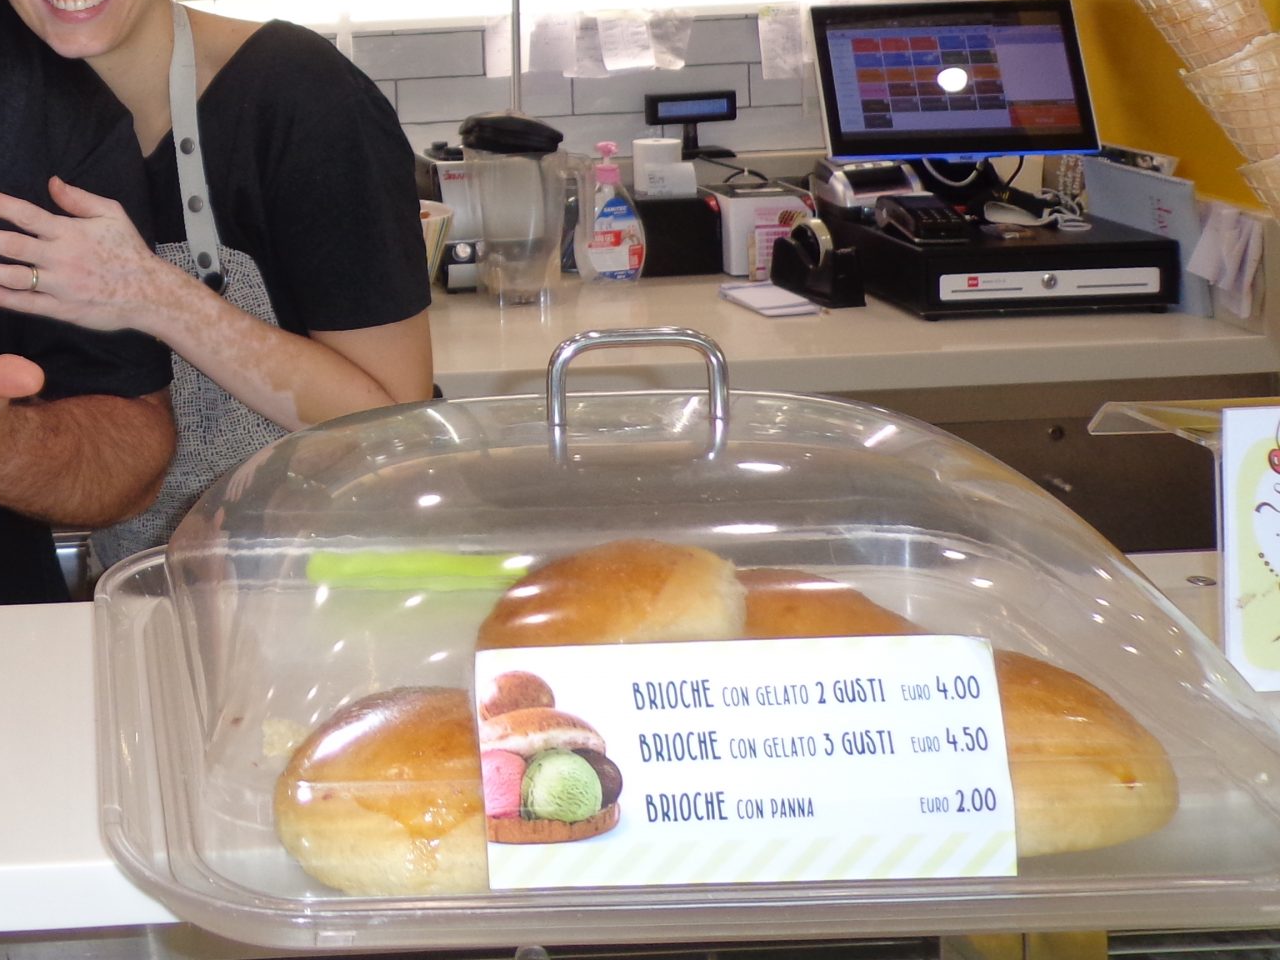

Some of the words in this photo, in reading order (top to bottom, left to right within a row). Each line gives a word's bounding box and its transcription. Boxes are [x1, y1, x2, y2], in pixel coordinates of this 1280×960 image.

[632, 679, 715, 710] BRIOCHE
[722, 686, 750, 707] CON
[755, 684, 809, 706] GELATO
[815, 681, 827, 704] 2
[833, 678, 886, 703] GUSTI
[900, 684, 931, 701] EURO
[936, 675, 980, 700] 4.00
[638, 731, 722, 762] BRIOCHE
[729, 738, 757, 759] CON
[763, 736, 817, 758] GELATO
[823, 733, 835, 756] 3
[841, 730, 895, 755] GUSTI
[910, 736, 941, 753] EURO
[946, 727, 989, 752] 4.50
[645, 791, 729, 822] BRIOCHE
[736, 798, 765, 819] CON
[770, 797, 815, 819] PANNA
[919, 797, 950, 814] EURO
[955, 787, 997, 812] 2.00
